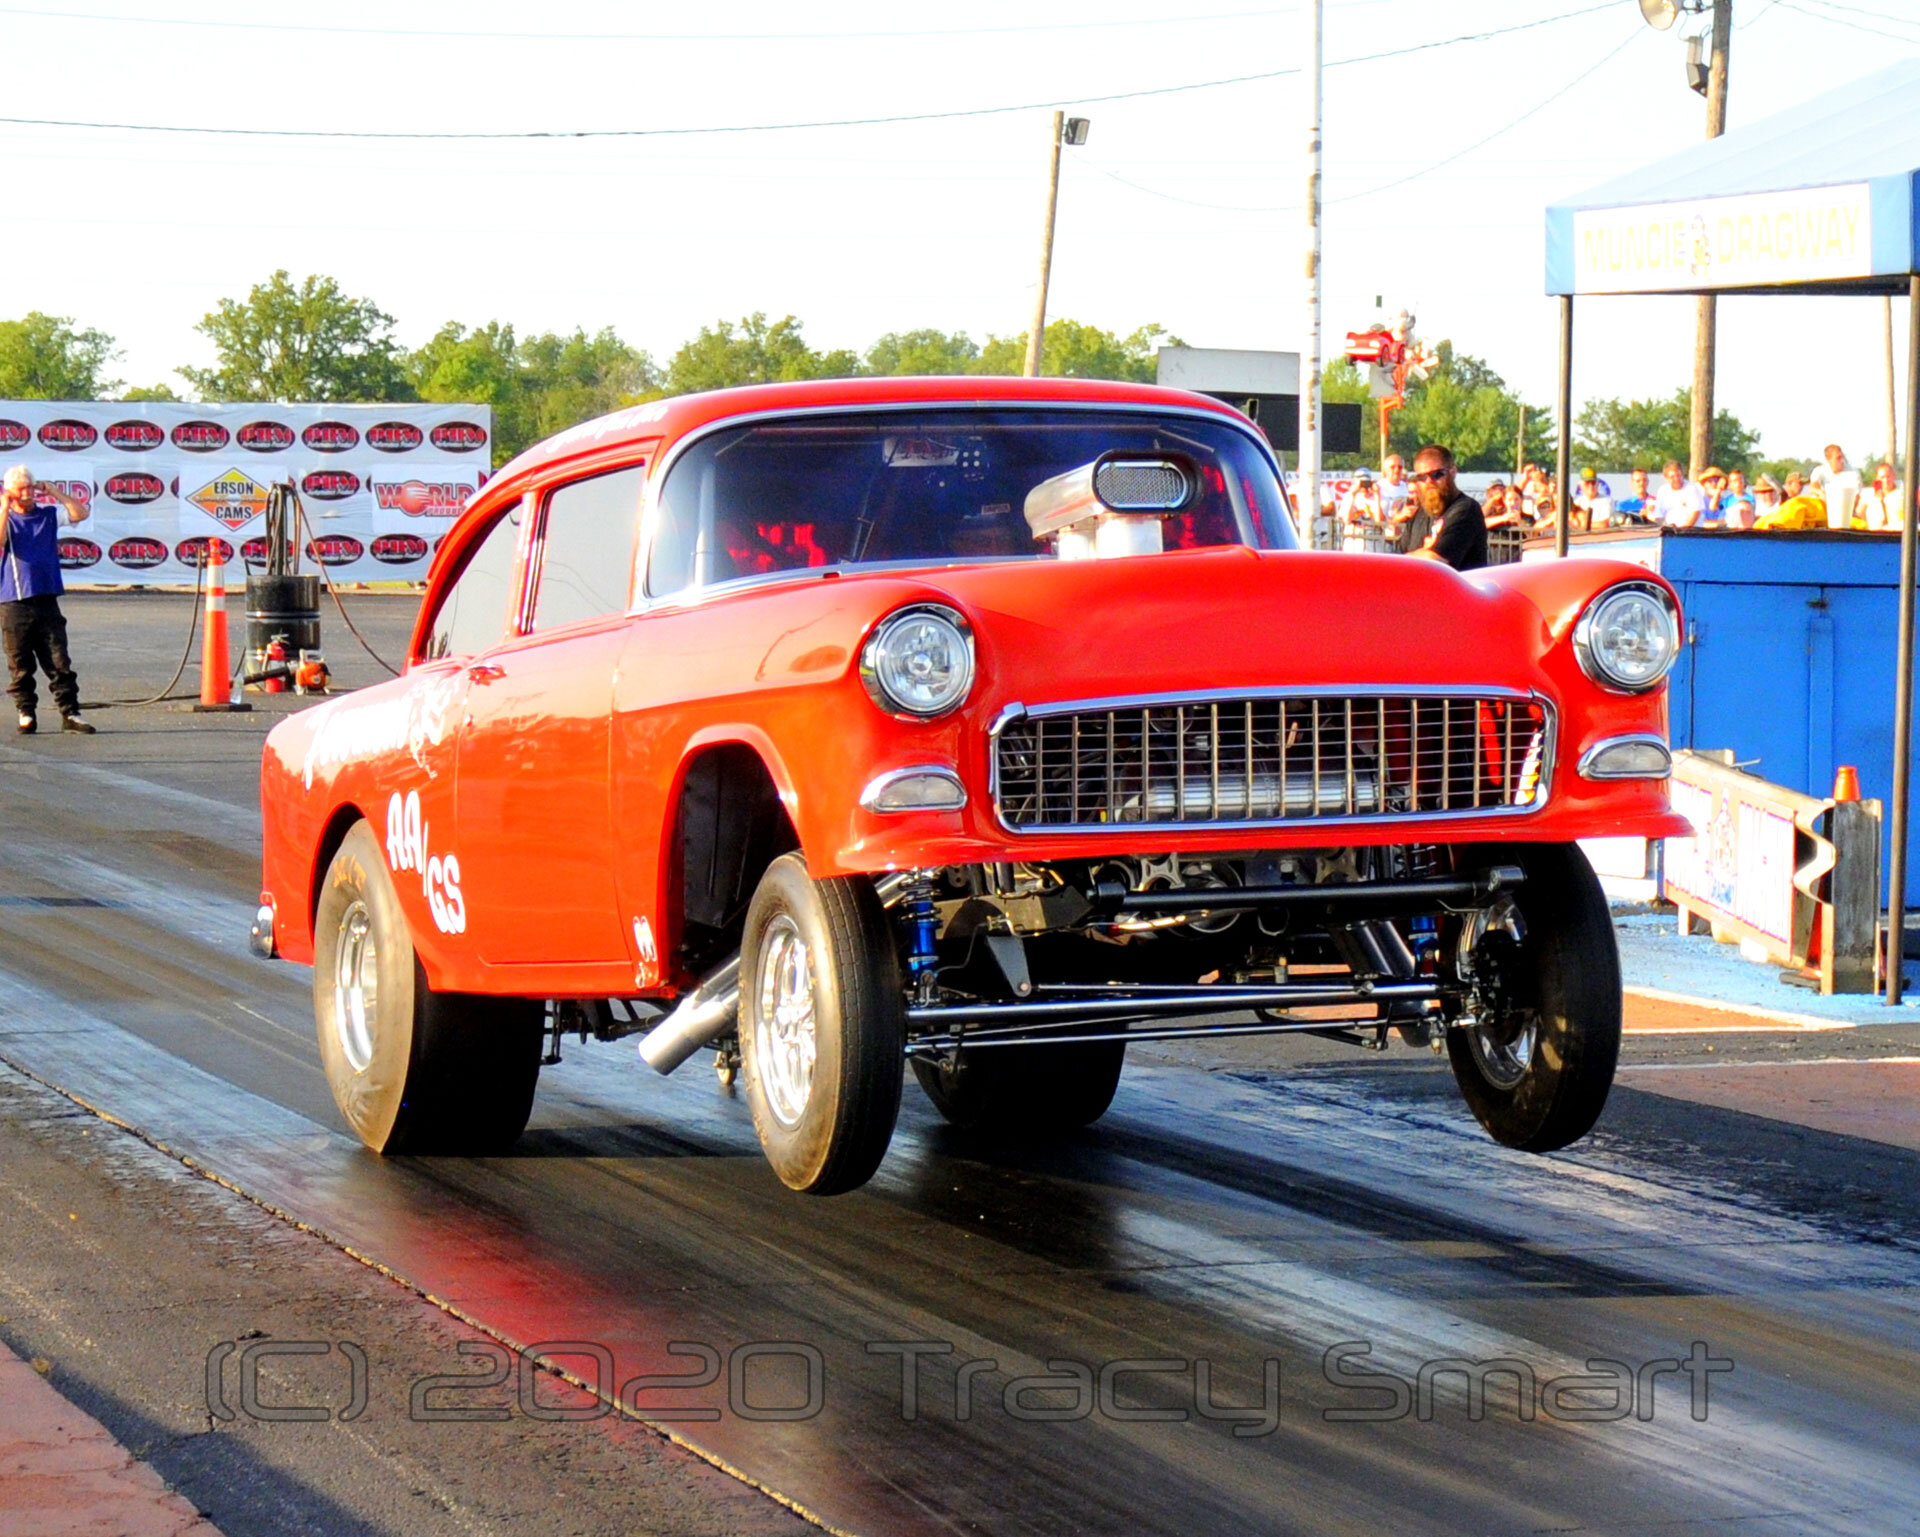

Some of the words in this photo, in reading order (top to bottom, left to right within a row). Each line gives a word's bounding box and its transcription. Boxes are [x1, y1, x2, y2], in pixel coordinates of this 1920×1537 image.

[1584, 221, 1685, 273] MUNCIE
[1717, 204, 1861, 265] DRAGWAY
[213, 481, 254, 495] ERSON
[215, 506, 252, 519] CAMS
